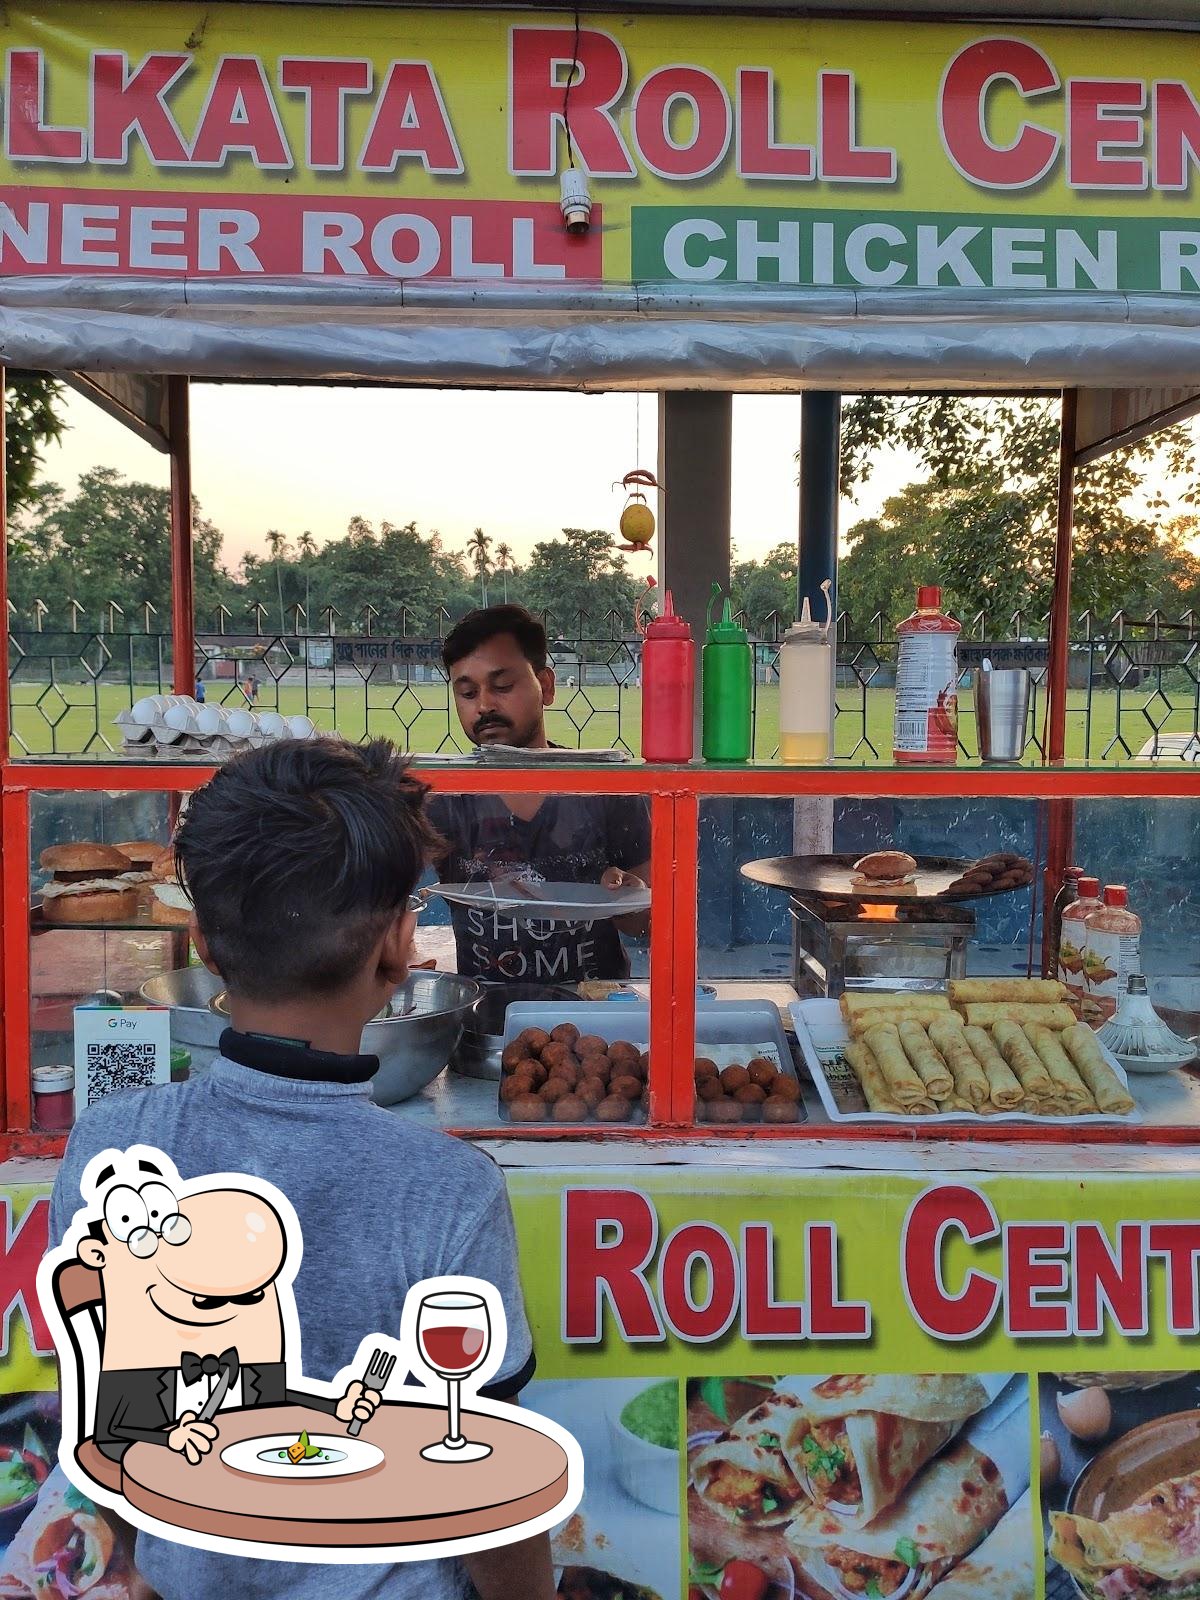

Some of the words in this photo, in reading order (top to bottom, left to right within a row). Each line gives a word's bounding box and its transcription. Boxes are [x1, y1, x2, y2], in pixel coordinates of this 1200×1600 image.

[4, 48, 465, 174] LKATA
[303, 211, 566, 278] ROLL
[663, 218, 1118, 290] CHICKEN
[108, 1018, 118, 1028] G
[120, 1018, 138, 1030] Pay
